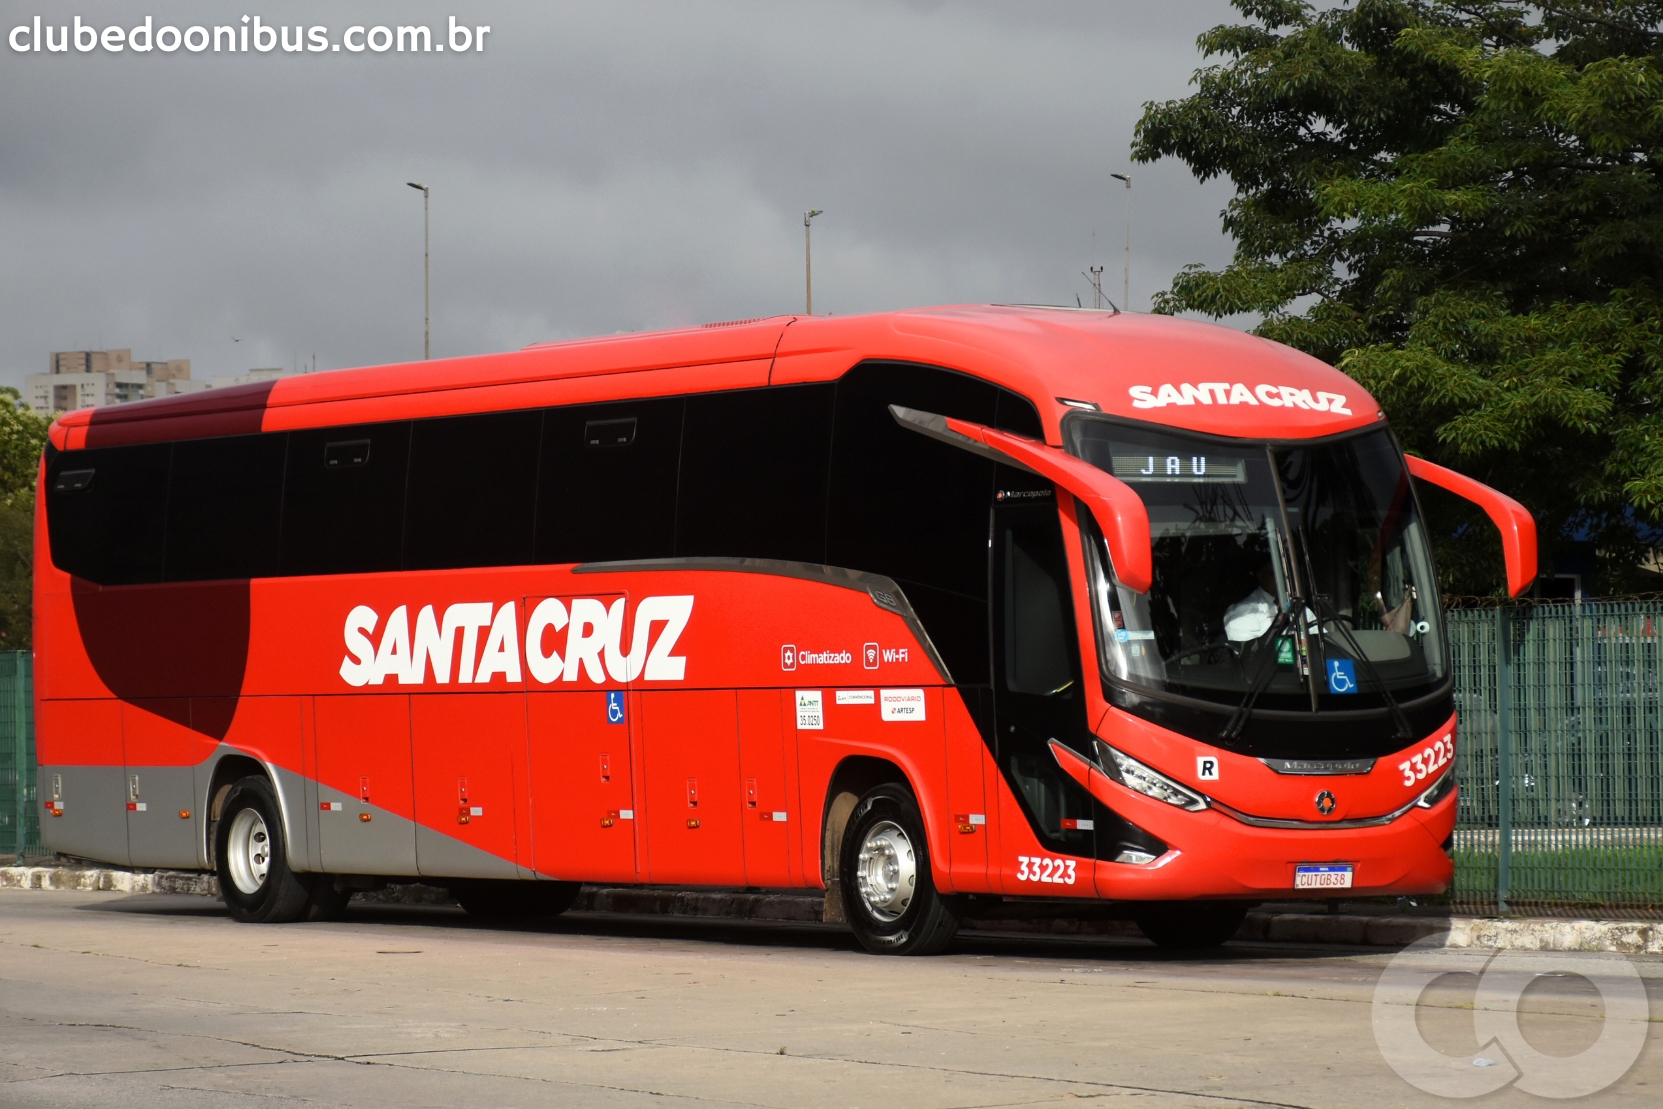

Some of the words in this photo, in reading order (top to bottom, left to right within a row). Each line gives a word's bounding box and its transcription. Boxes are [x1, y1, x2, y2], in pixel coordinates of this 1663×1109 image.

[799, 650, 852, 664] Climatizado
[882, 648, 908, 662] Wi-Fi
[1201, 760, 1215, 776] R
[1398, 733, 1454, 787] 33223
[1016, 855, 1076, 885] 33223
